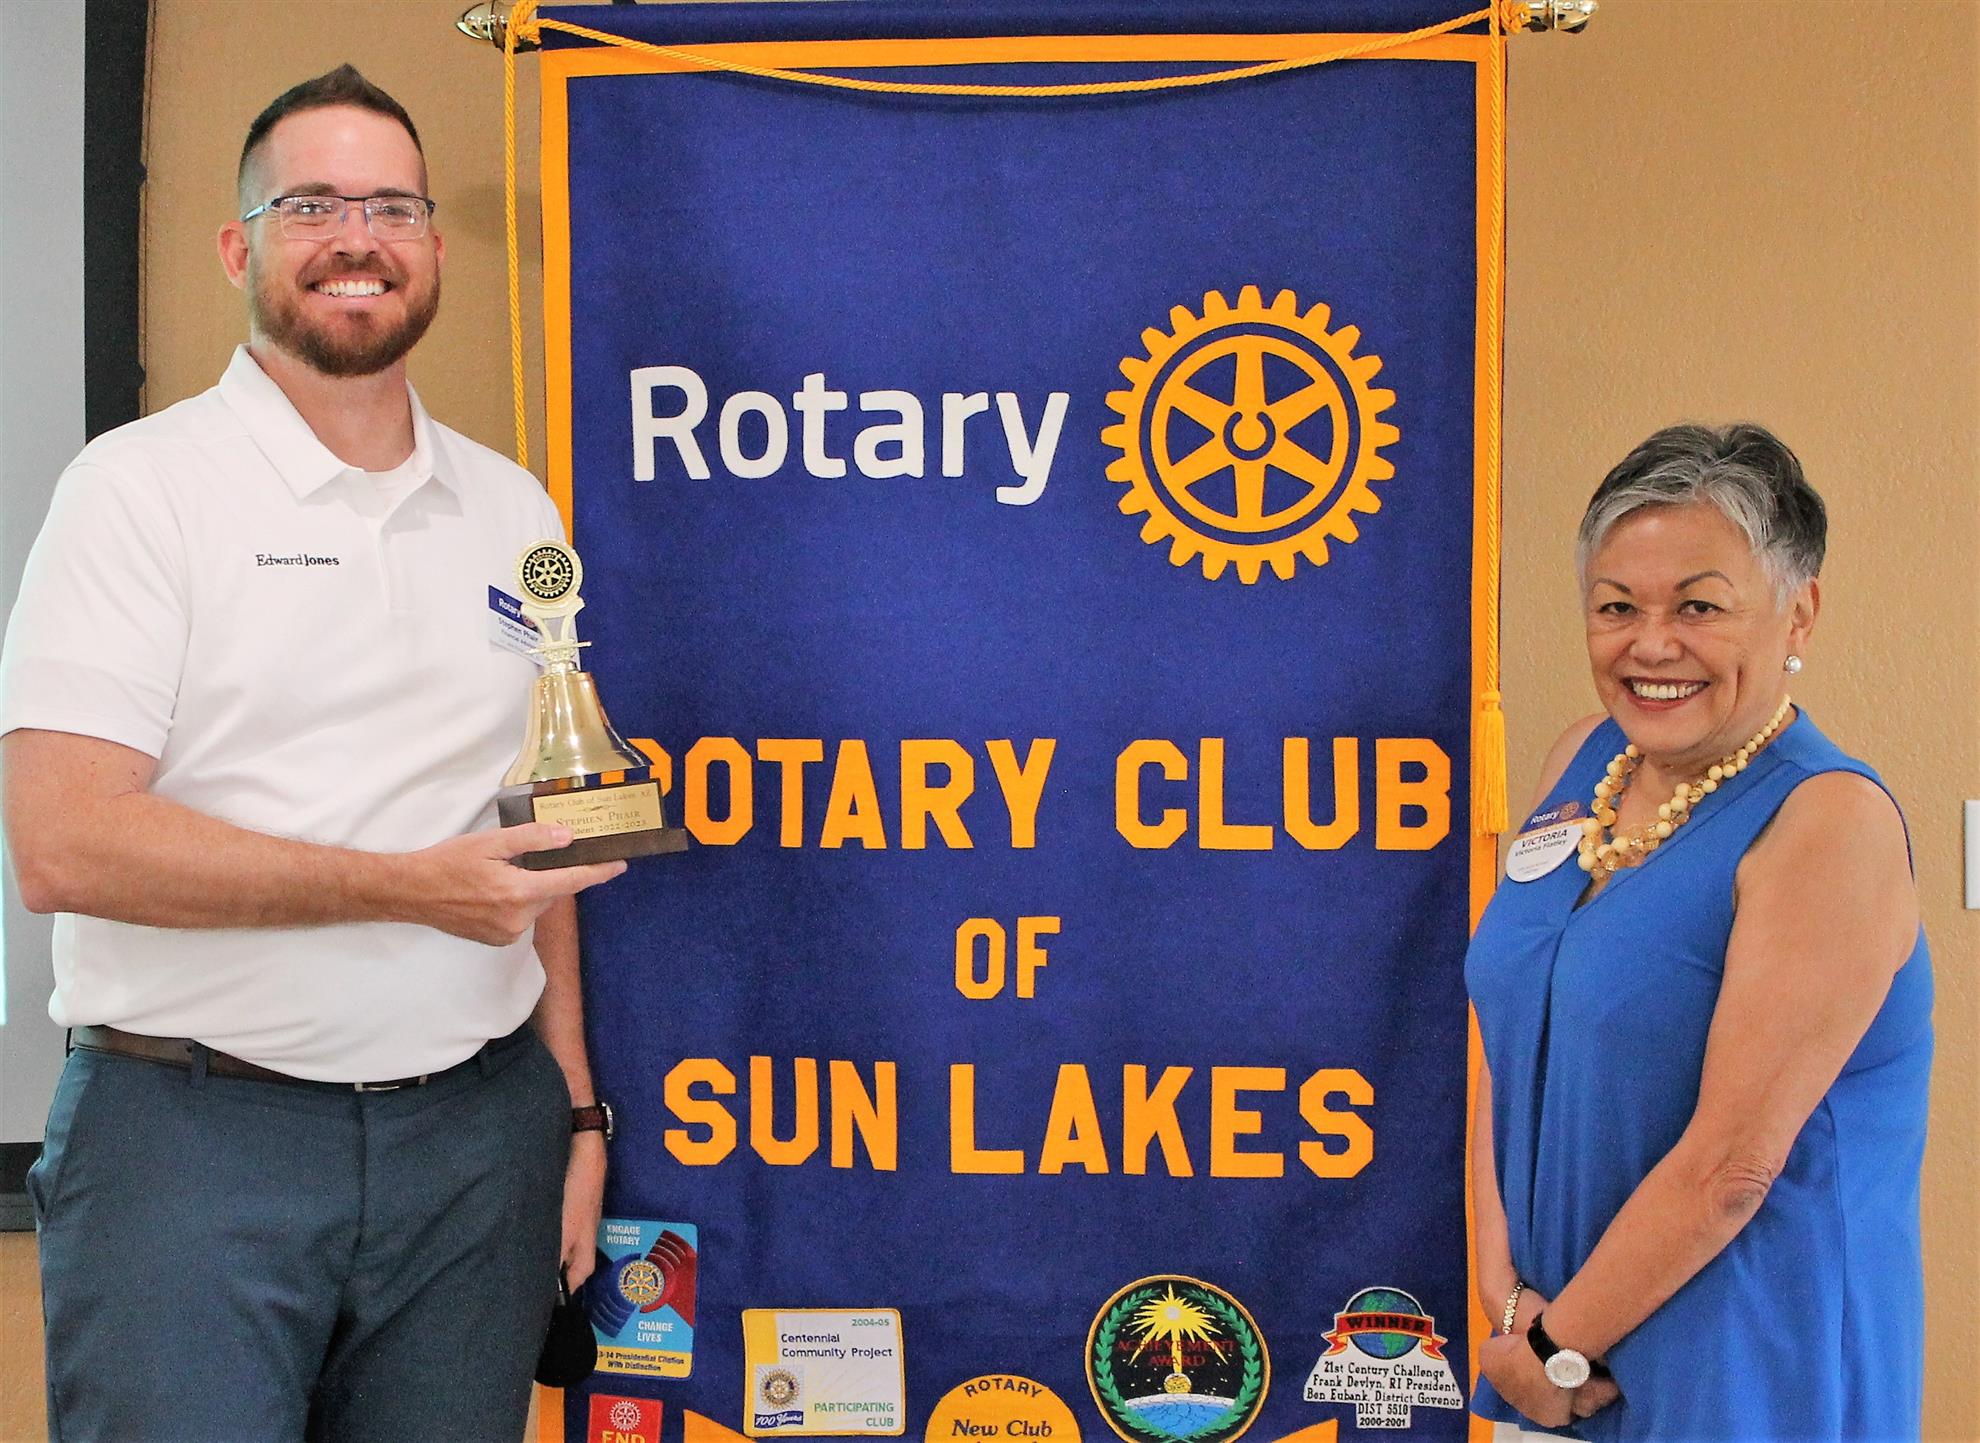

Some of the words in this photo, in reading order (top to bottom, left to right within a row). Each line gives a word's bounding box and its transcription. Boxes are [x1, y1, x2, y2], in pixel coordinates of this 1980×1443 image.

[629, 365, 1070, 506] Rotary
[255, 553, 303, 566] Edward
[303, 554, 340, 566] Jones
[498, 597, 520, 618] Rotary
[1115, 736, 1452, 852] CLUB
[1530, 810, 1560, 825] Rotary
[1521, 829, 1568, 848] VICTORIA
[954, 916, 1061, 1000] OF
[664, 1055, 897, 1172] SUN
[949, 1063, 1374, 1179] LAKES
[606, 1224, 640, 1236] ENGAGE
[606, 1235, 640, 1246] ROTARY
[638, 1320, 674, 1332] CHANGE
[852, 1318, 890, 1327] 2004-05
[1346, 1316, 1426, 1332] WINNER
[637, 1332, 662, 1343] LIVES
[781, 1333, 840, 1343] Centennial
[1117, 1340, 1236, 1352] ACHIEVEMENT
[599, 1350, 614, 1359] 3-14
[615, 1352, 657, 1363] Presidential
[782, 1348, 847, 1360] Community
[851, 1347, 893, 1360] Project
[607, 1361, 624, 1369] With
[624, 1361, 662, 1372] Distinction
[1148, 1356, 1207, 1367] AWARD
[1324, 1361, 1344, 1374] 21st
[1348, 1362, 1390, 1378] Century
[1393, 1364, 1445, 1381] Challenge
[963, 1377, 1043, 1398] ROTARY
[1313, 1374, 1343, 1387] Frank
[1389, 1378, 1402, 1390] RI
[1406, 1378, 1456, 1393] President
[1307, 1388, 1326, 1400] Ben
[1375, 1390, 1414, 1403] District
[1417, 1392, 1461, 1407] Govenor
[814, 1402, 895, 1413] PARTICIPATING
[1357, 1403, 1383, 1415] DIST
[755, 1415, 776, 1427] 100
[865, 1417, 895, 1427] CLUB
[1359, 1417, 1406, 1427] 2000-2001
[951, 1419, 998, 1437] New
[1006, 1419, 1053, 1437] Club
[602, 1430, 646, 1443] END
